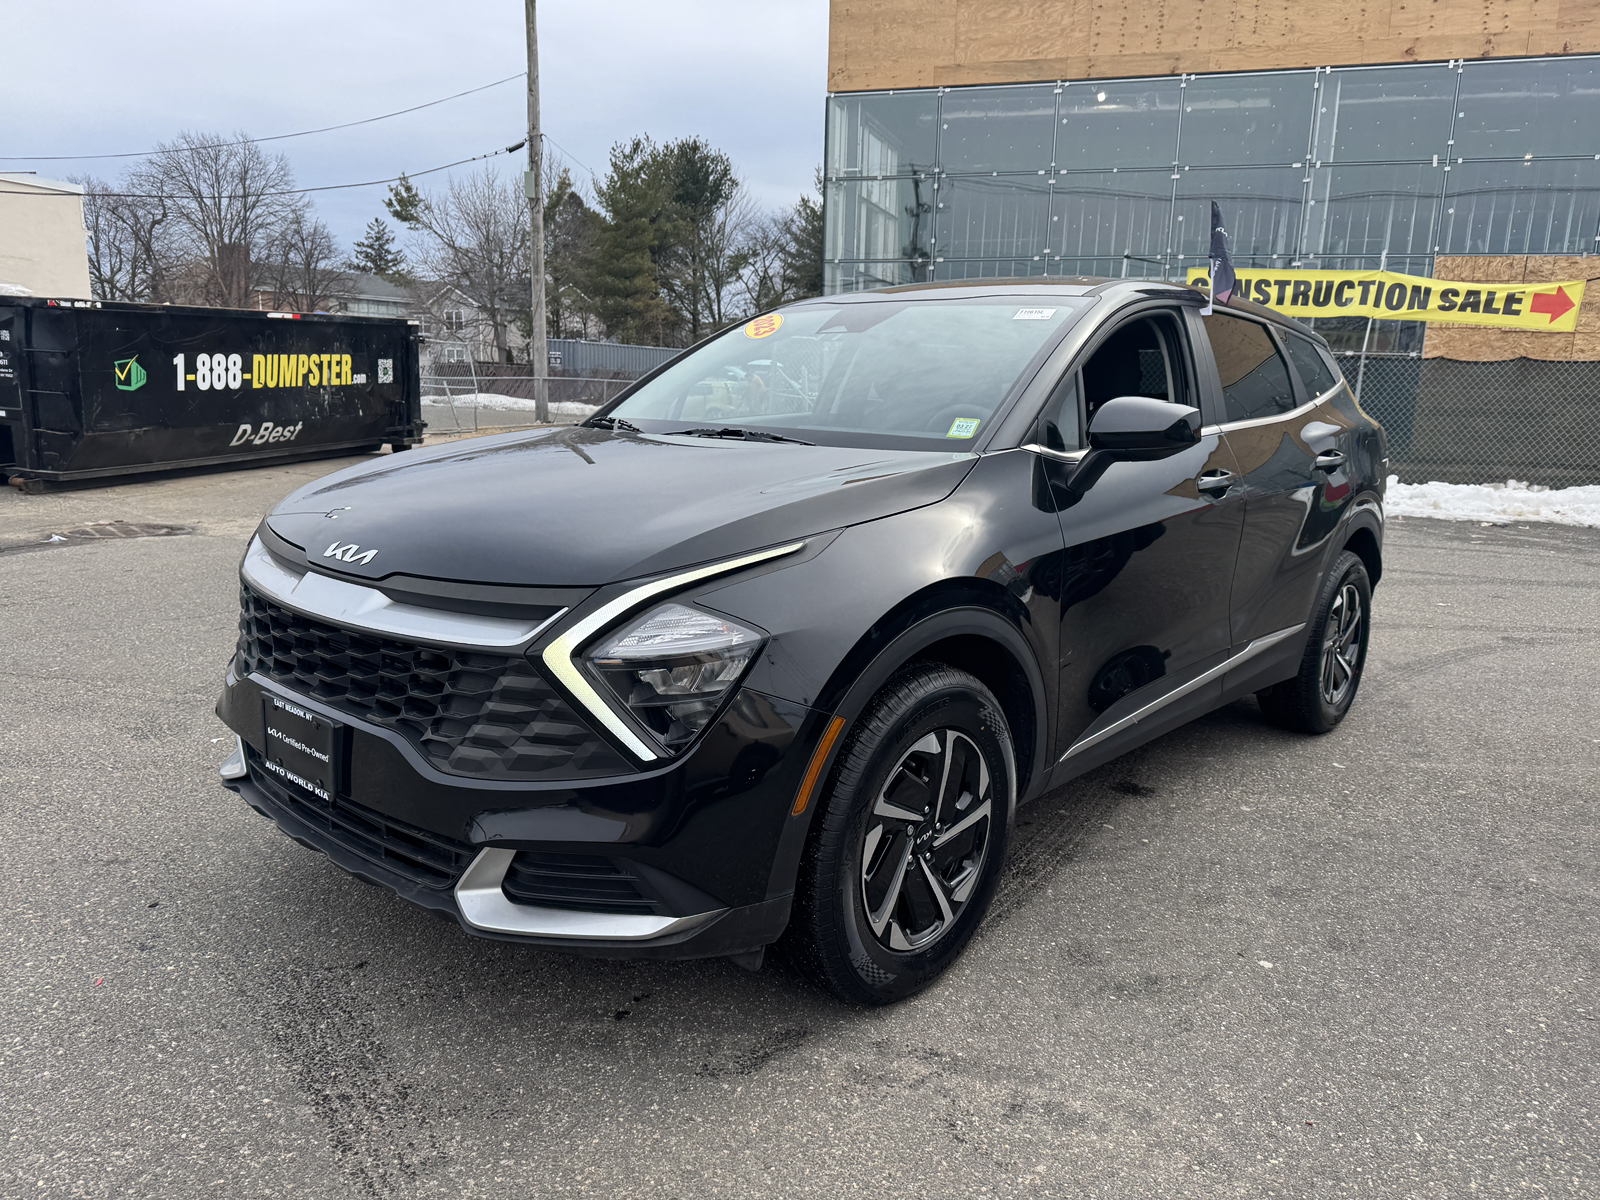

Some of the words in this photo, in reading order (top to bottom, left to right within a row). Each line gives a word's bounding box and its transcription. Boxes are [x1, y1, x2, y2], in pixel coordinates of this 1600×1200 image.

[1191, 277, 1432, 311] NSTRUCTION
[1437, 288, 1526, 316] SALE
[753, 315, 776, 336] 2023
[229, 421, 303, 447] D-Best
[323, 540, 379, 566] KIA
[273, 698, 285, 709] EAST
[305, 713, 314, 722] NY
[267, 726, 282, 739] KIA
[282, 734, 302, 751] Certified
[301, 743, 329, 763] Pre-Owned
[265, 760, 285, 776] AUTO
[286, 771, 314, 792] WORLD
[314, 787, 330, 801] KIA
